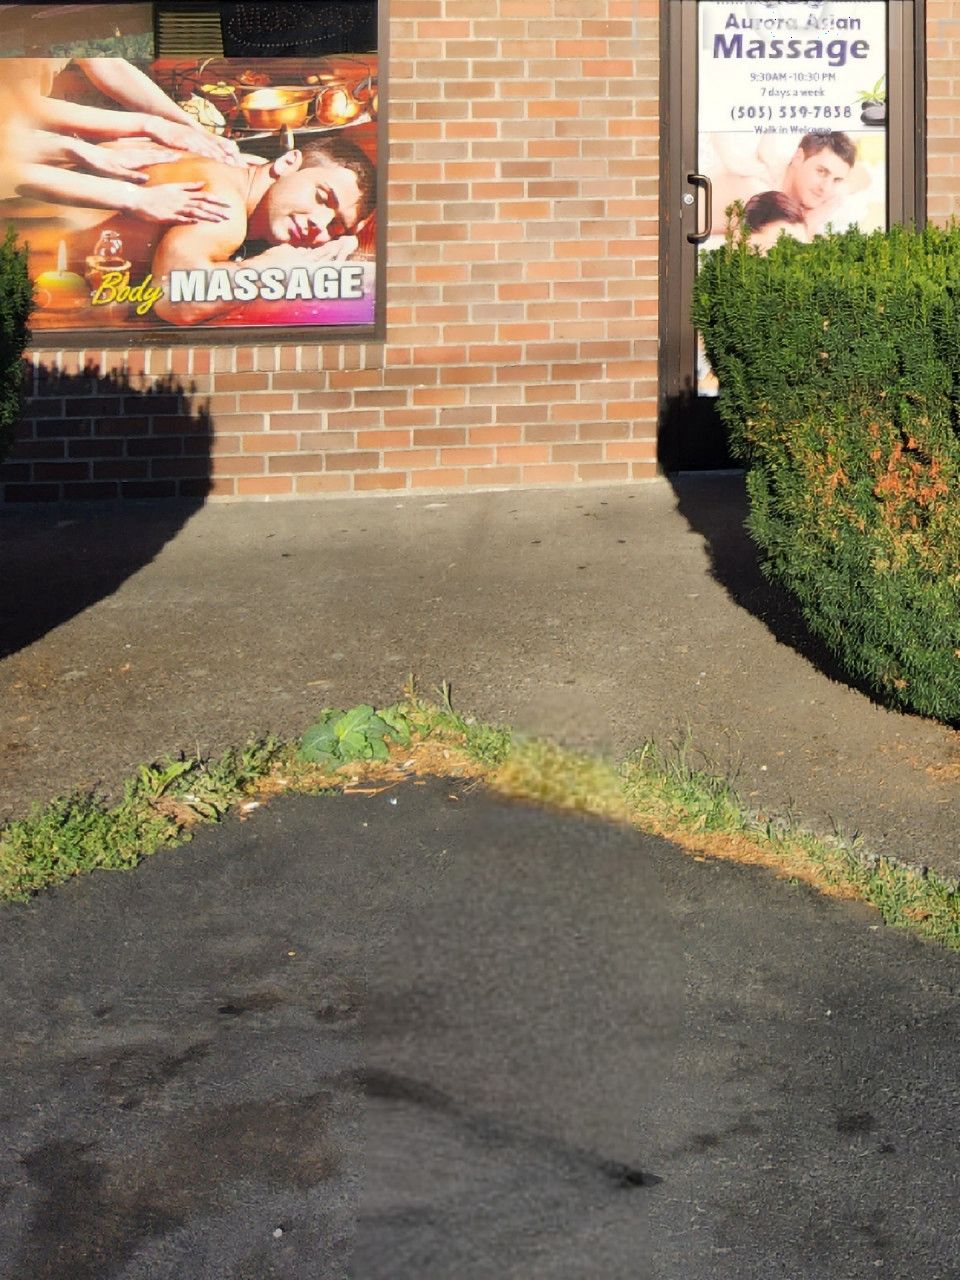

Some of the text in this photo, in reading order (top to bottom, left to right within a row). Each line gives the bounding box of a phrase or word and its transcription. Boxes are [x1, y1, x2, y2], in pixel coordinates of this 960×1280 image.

[713, 33, 870, 67] Massage
[761, 87, 767, 97] 7
[768, 86, 791, 100] days
[800, 86, 825, 97] week
[91, 266, 365, 316] Body MASSAGE
